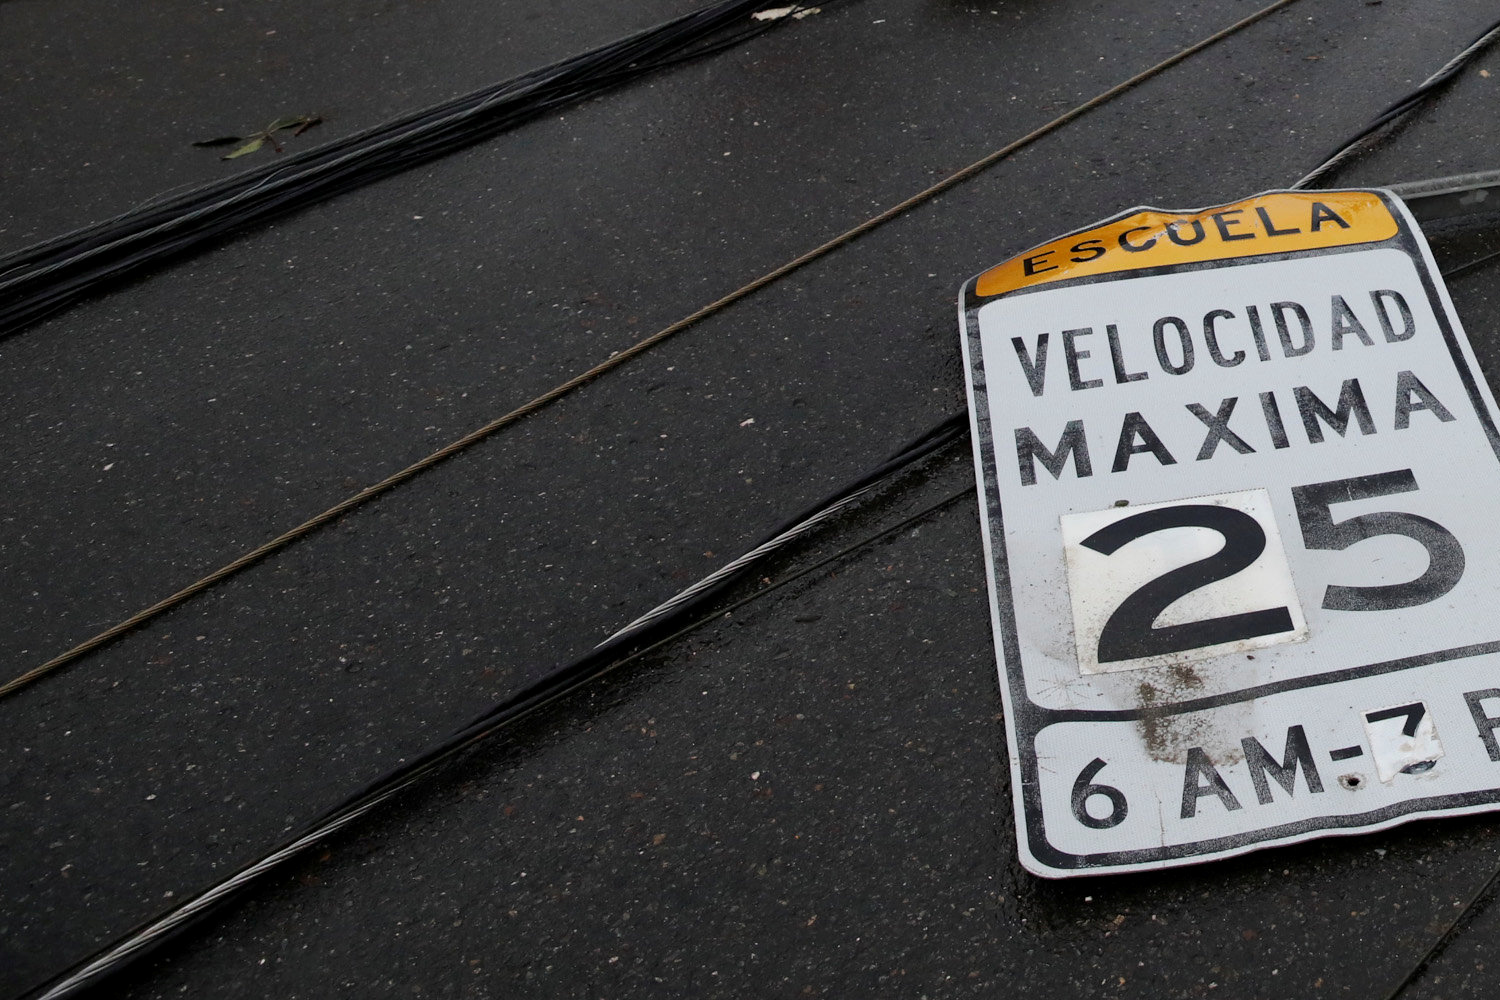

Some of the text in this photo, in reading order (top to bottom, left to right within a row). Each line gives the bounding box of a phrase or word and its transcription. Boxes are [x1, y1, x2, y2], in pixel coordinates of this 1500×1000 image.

[1023, 201, 1351, 277] ESCUELA
[1011, 288, 1418, 397] VELOCIDAD
[1012, 370, 1457, 487] MAXIMA
[1079, 467, 1466, 664] 25
[1070, 757, 1129, 830] 6
